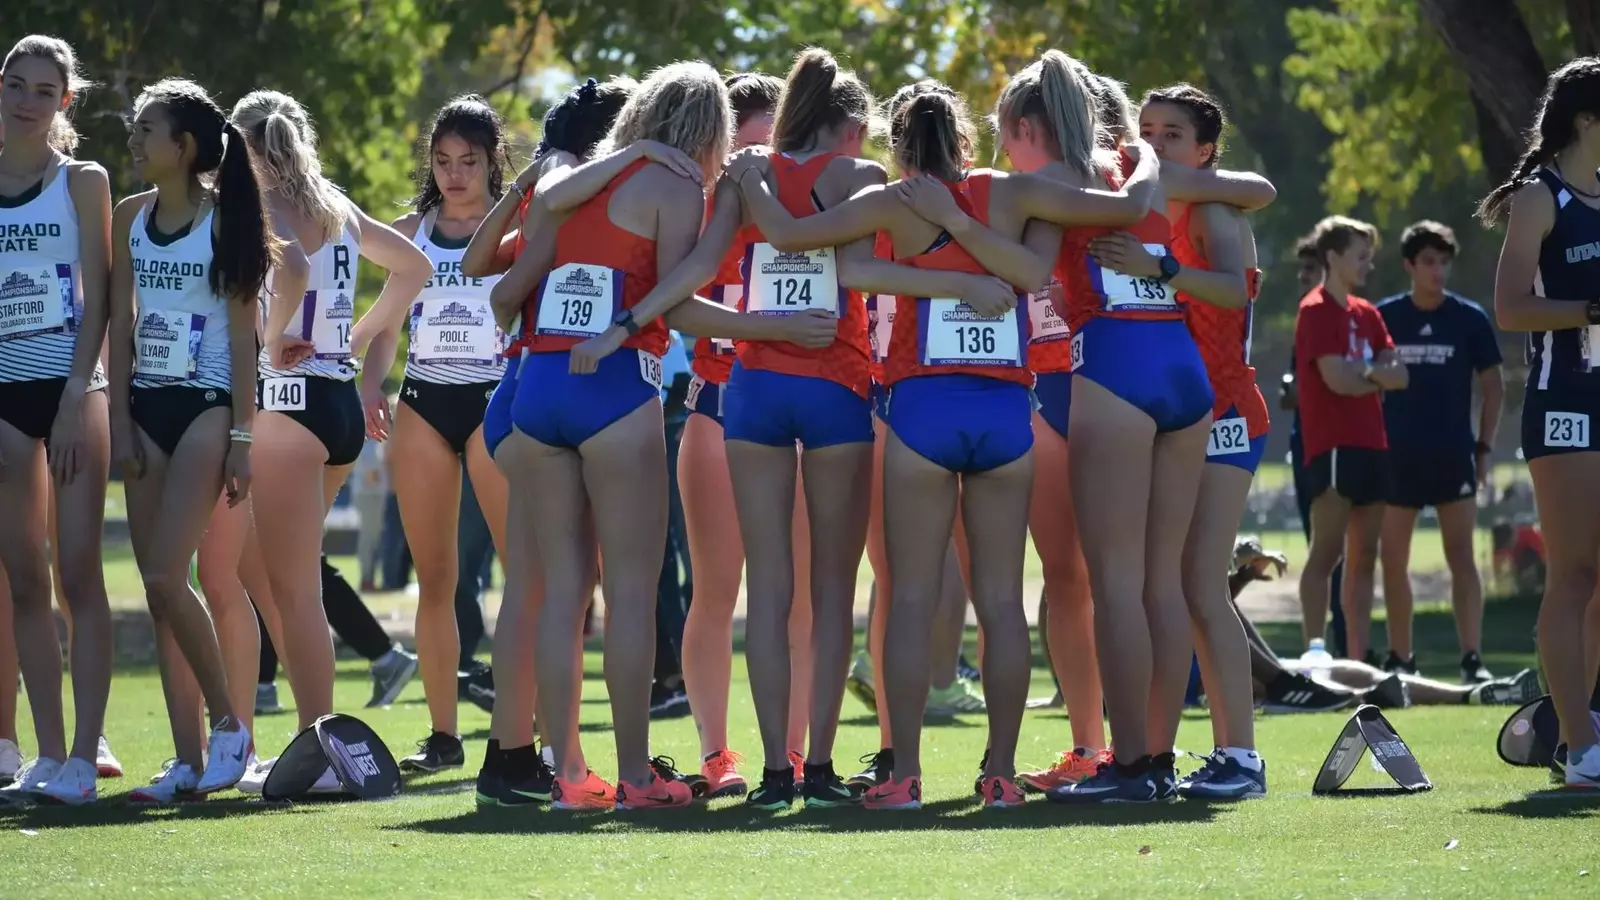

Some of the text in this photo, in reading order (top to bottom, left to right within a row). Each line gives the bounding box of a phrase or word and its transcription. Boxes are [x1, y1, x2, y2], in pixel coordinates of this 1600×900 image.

[132, 258, 203, 277] OLORADO
[762, 263, 822, 272] CHAMPIONSHIPS
[140, 274, 183, 290] STATE
[424, 274, 482, 288] STATE
[555, 283, 603, 296] CHAMPIONSHIPS
[1129, 277, 1166, 299] 133
[773, 278, 812, 305] 124
[0, 301, 44, 319] STAFFORD
[561, 299, 593, 327] 139
[1, 316, 43, 328] COLORADO STATE
[428, 316, 483, 325] CHAMPIONSHIPS
[440, 330, 469, 343] POOLE
[956, 326, 995, 354] 136
[459, 345, 476, 353] STATE
[643, 357, 662, 386] 139
[269, 383, 301, 405] 140
[1210, 424, 1245, 449] 132
[1550, 417, 1583, 442] 231
[353, 754, 380, 776] WEST
